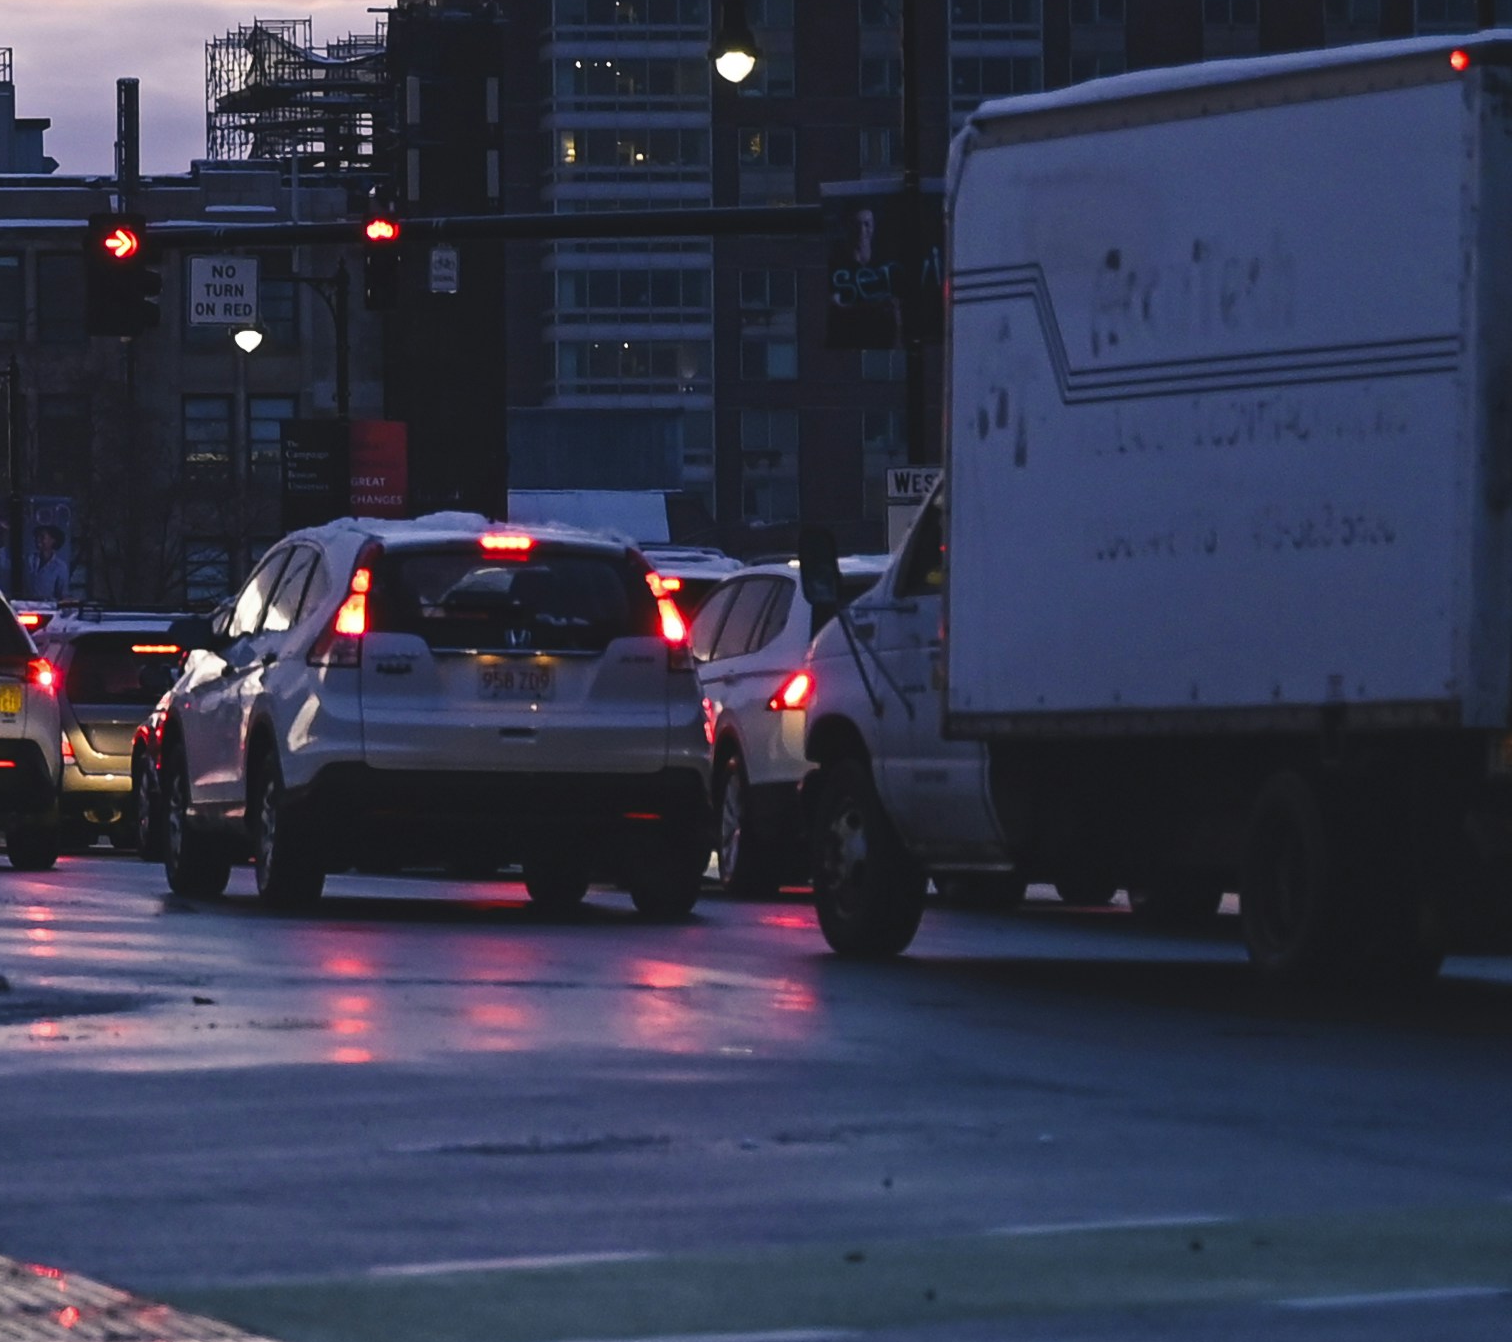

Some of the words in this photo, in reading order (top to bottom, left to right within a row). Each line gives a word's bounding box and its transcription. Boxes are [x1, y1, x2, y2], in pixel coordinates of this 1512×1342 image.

[212, 265, 237, 279] NO
[205, 283, 245, 297] TURN
[195, 302, 215, 316] ON
[224, 302, 253, 316] RED
[351, 477, 386, 487] GREAT
[894, 472, 941, 494] WES
[350, 495, 403, 505] CHANGES
